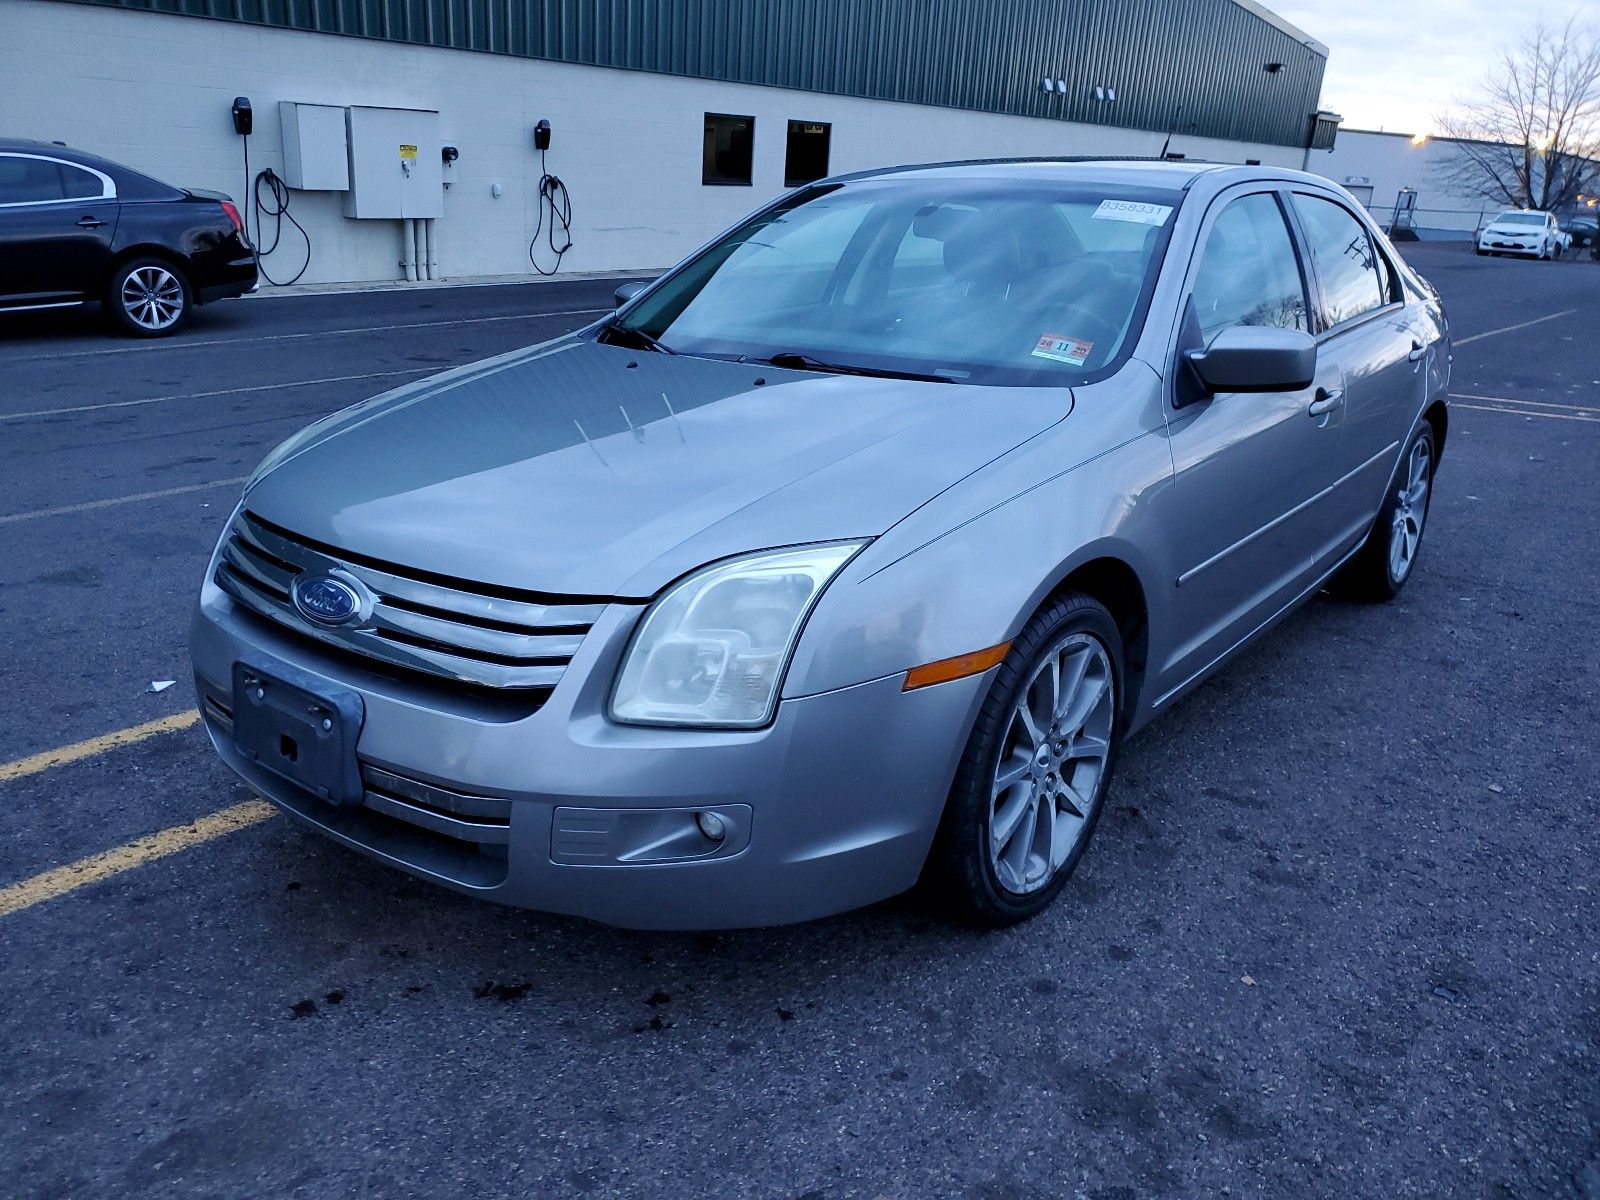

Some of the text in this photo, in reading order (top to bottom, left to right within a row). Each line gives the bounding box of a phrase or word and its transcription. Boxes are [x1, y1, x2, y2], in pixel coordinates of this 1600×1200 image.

[1101, 202, 1162, 214] 8358331
[1057, 342, 1069, 352] 11
[1073, 346, 1087, 354] 20
[304, 583, 343, 611] Ford
